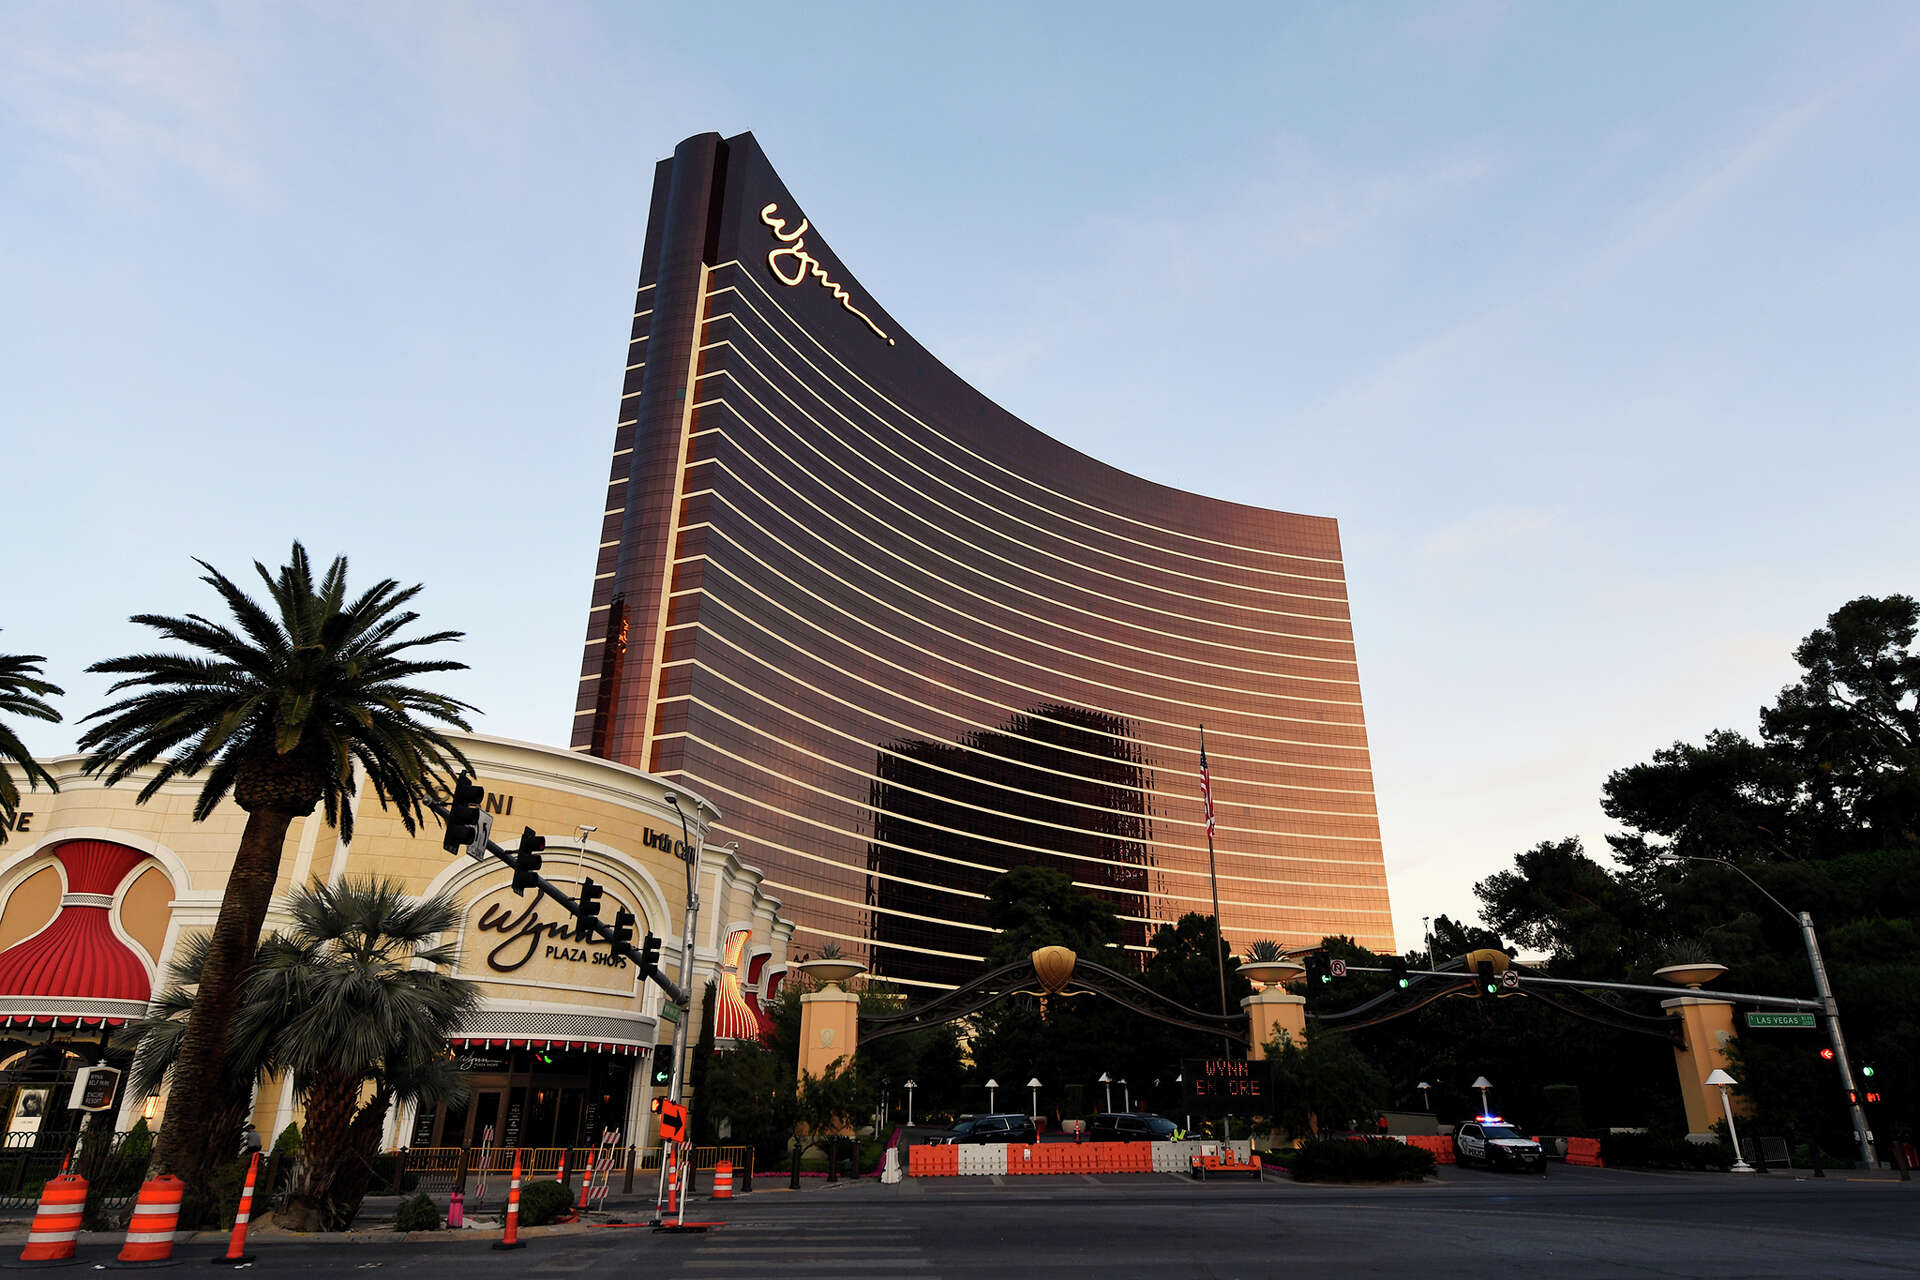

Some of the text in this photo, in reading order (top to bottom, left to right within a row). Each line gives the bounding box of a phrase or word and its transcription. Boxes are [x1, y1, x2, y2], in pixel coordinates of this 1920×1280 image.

[643, 826, 672, 854] Urth
[545, 945, 627, 969] PLAZA SHOPS
[1756, 1016, 1772, 1024] LAS
[1773, 1016, 1799, 1024] VEGAS
[1205, 1060, 1249, 1077] WYNN
[1195, 1080, 1261, 1096] ENORE
